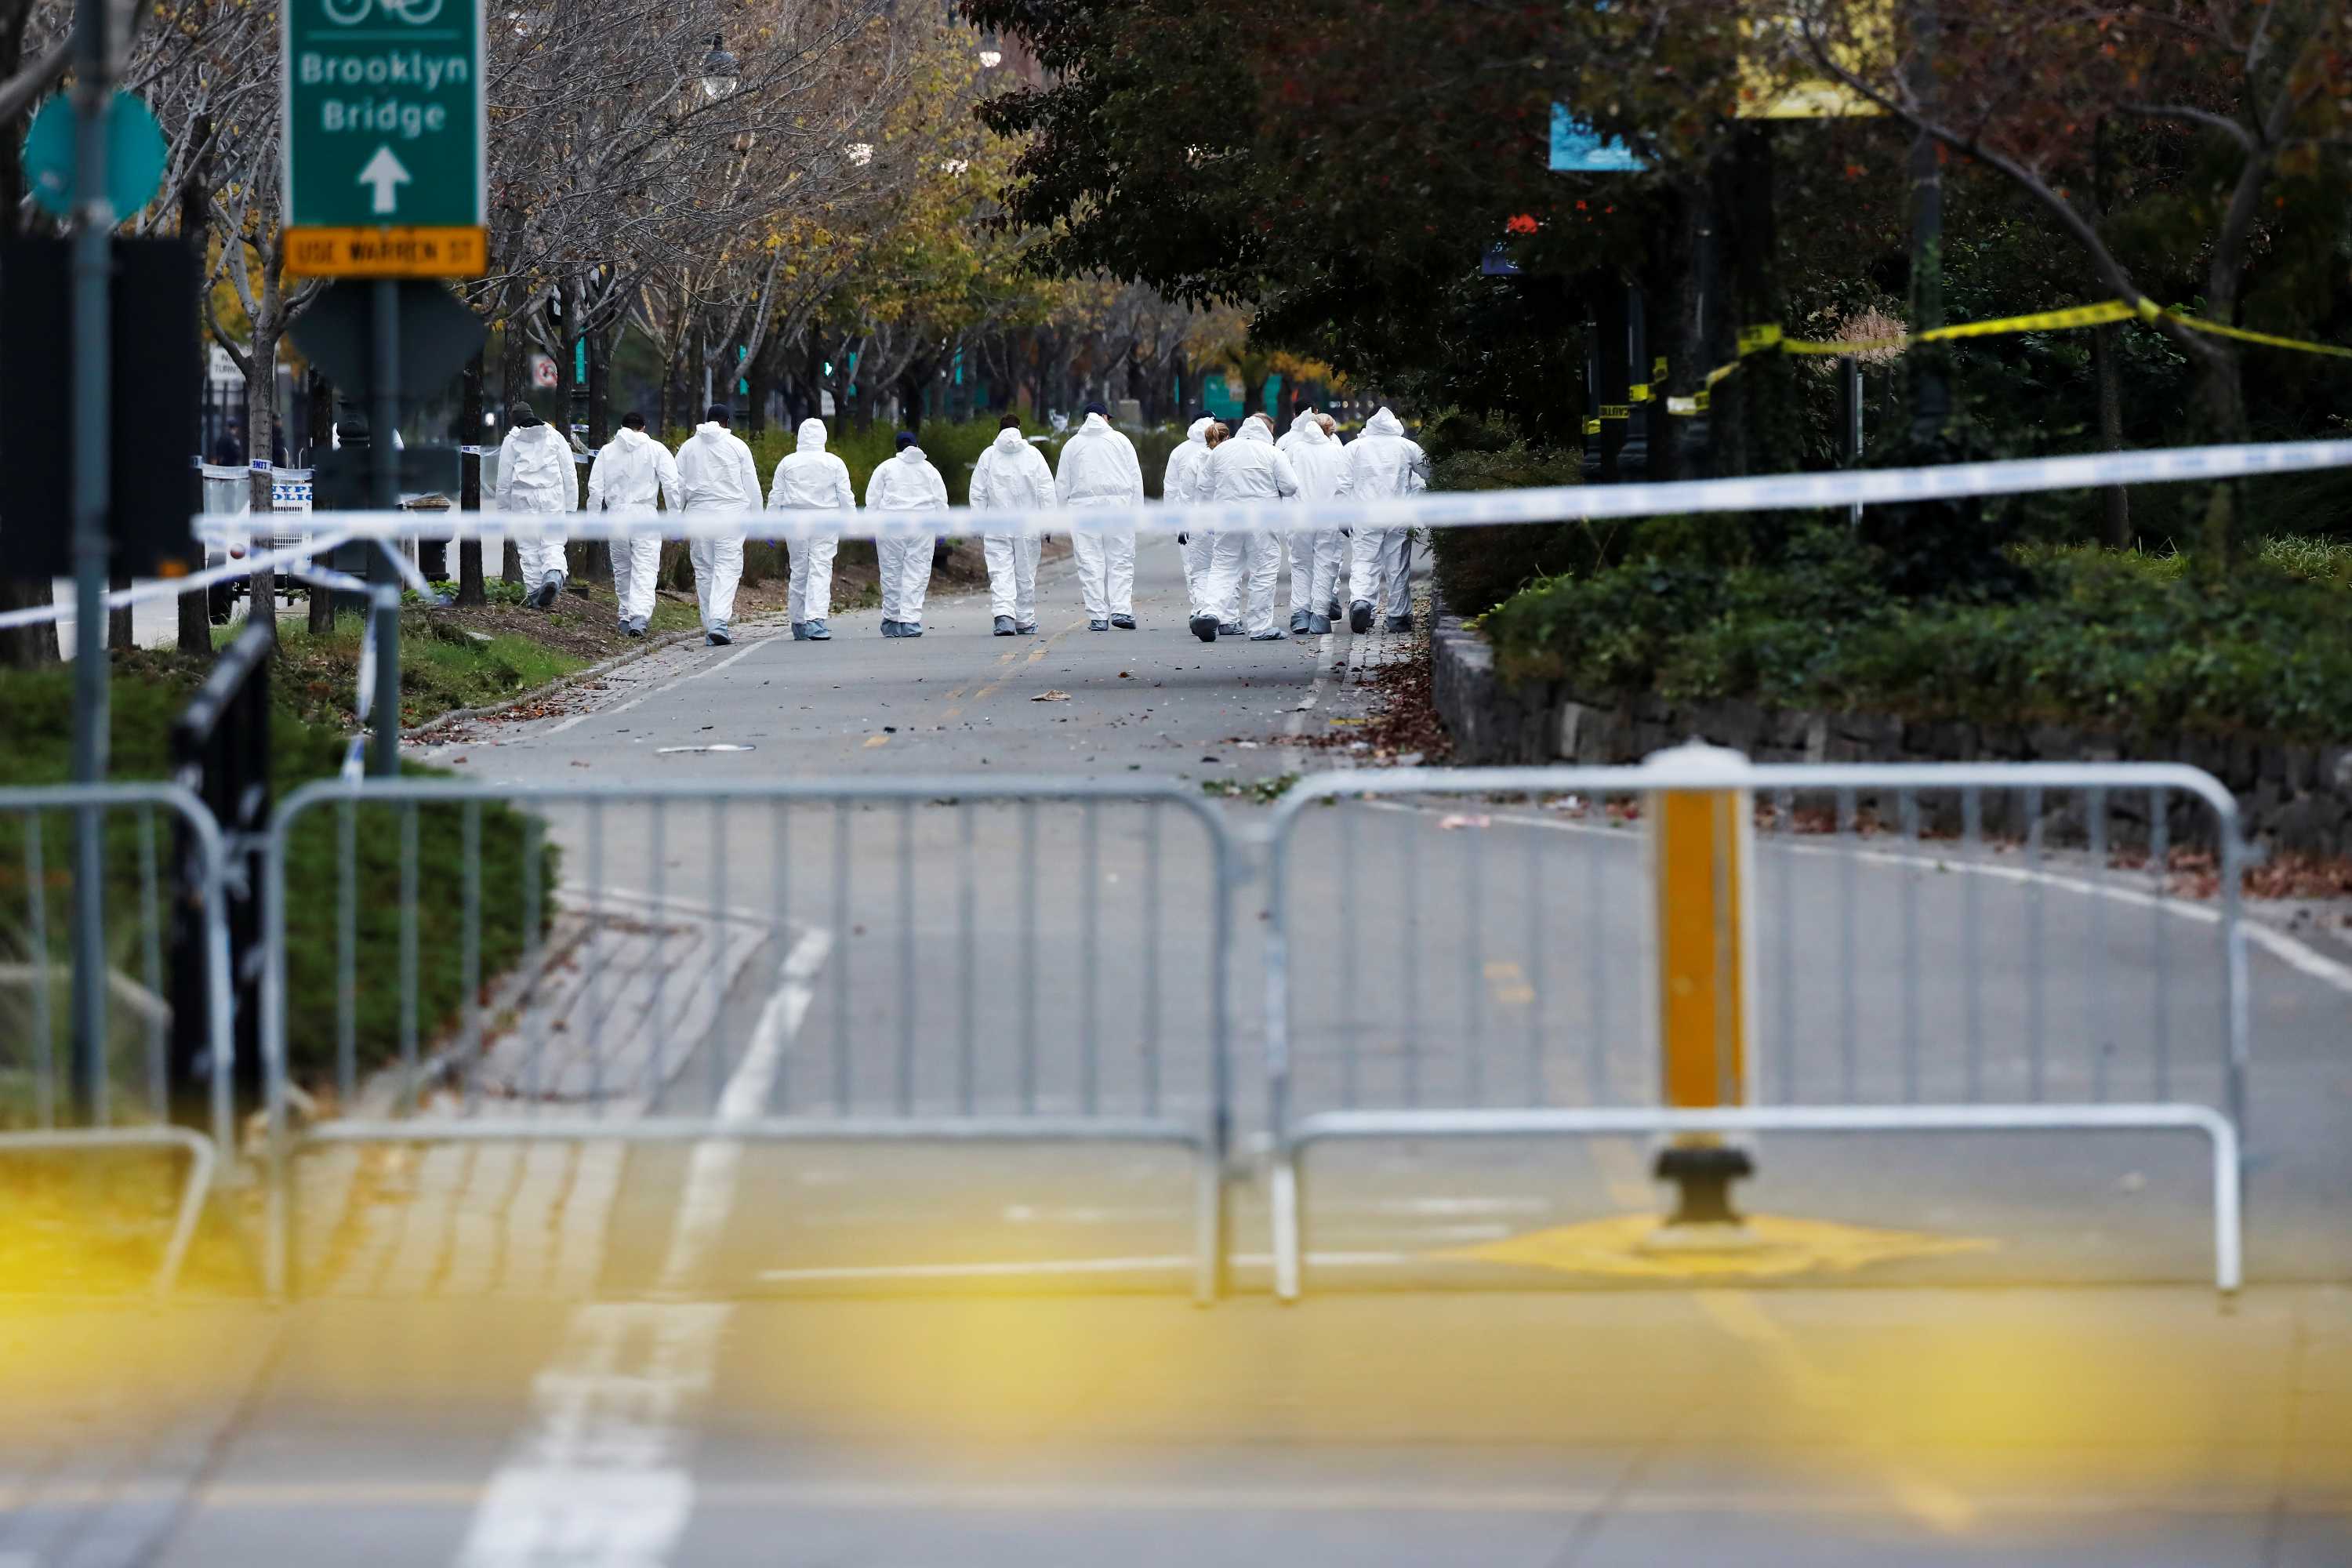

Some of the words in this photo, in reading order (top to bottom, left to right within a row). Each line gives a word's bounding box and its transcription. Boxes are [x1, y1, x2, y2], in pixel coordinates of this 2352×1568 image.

[300, 50, 468, 90] Brooklyn
[322, 96, 446, 138] Bridge
[297, 238, 337, 263] USE
[348, 238, 437, 262] WARREN
[449, 238, 473, 263] ST
